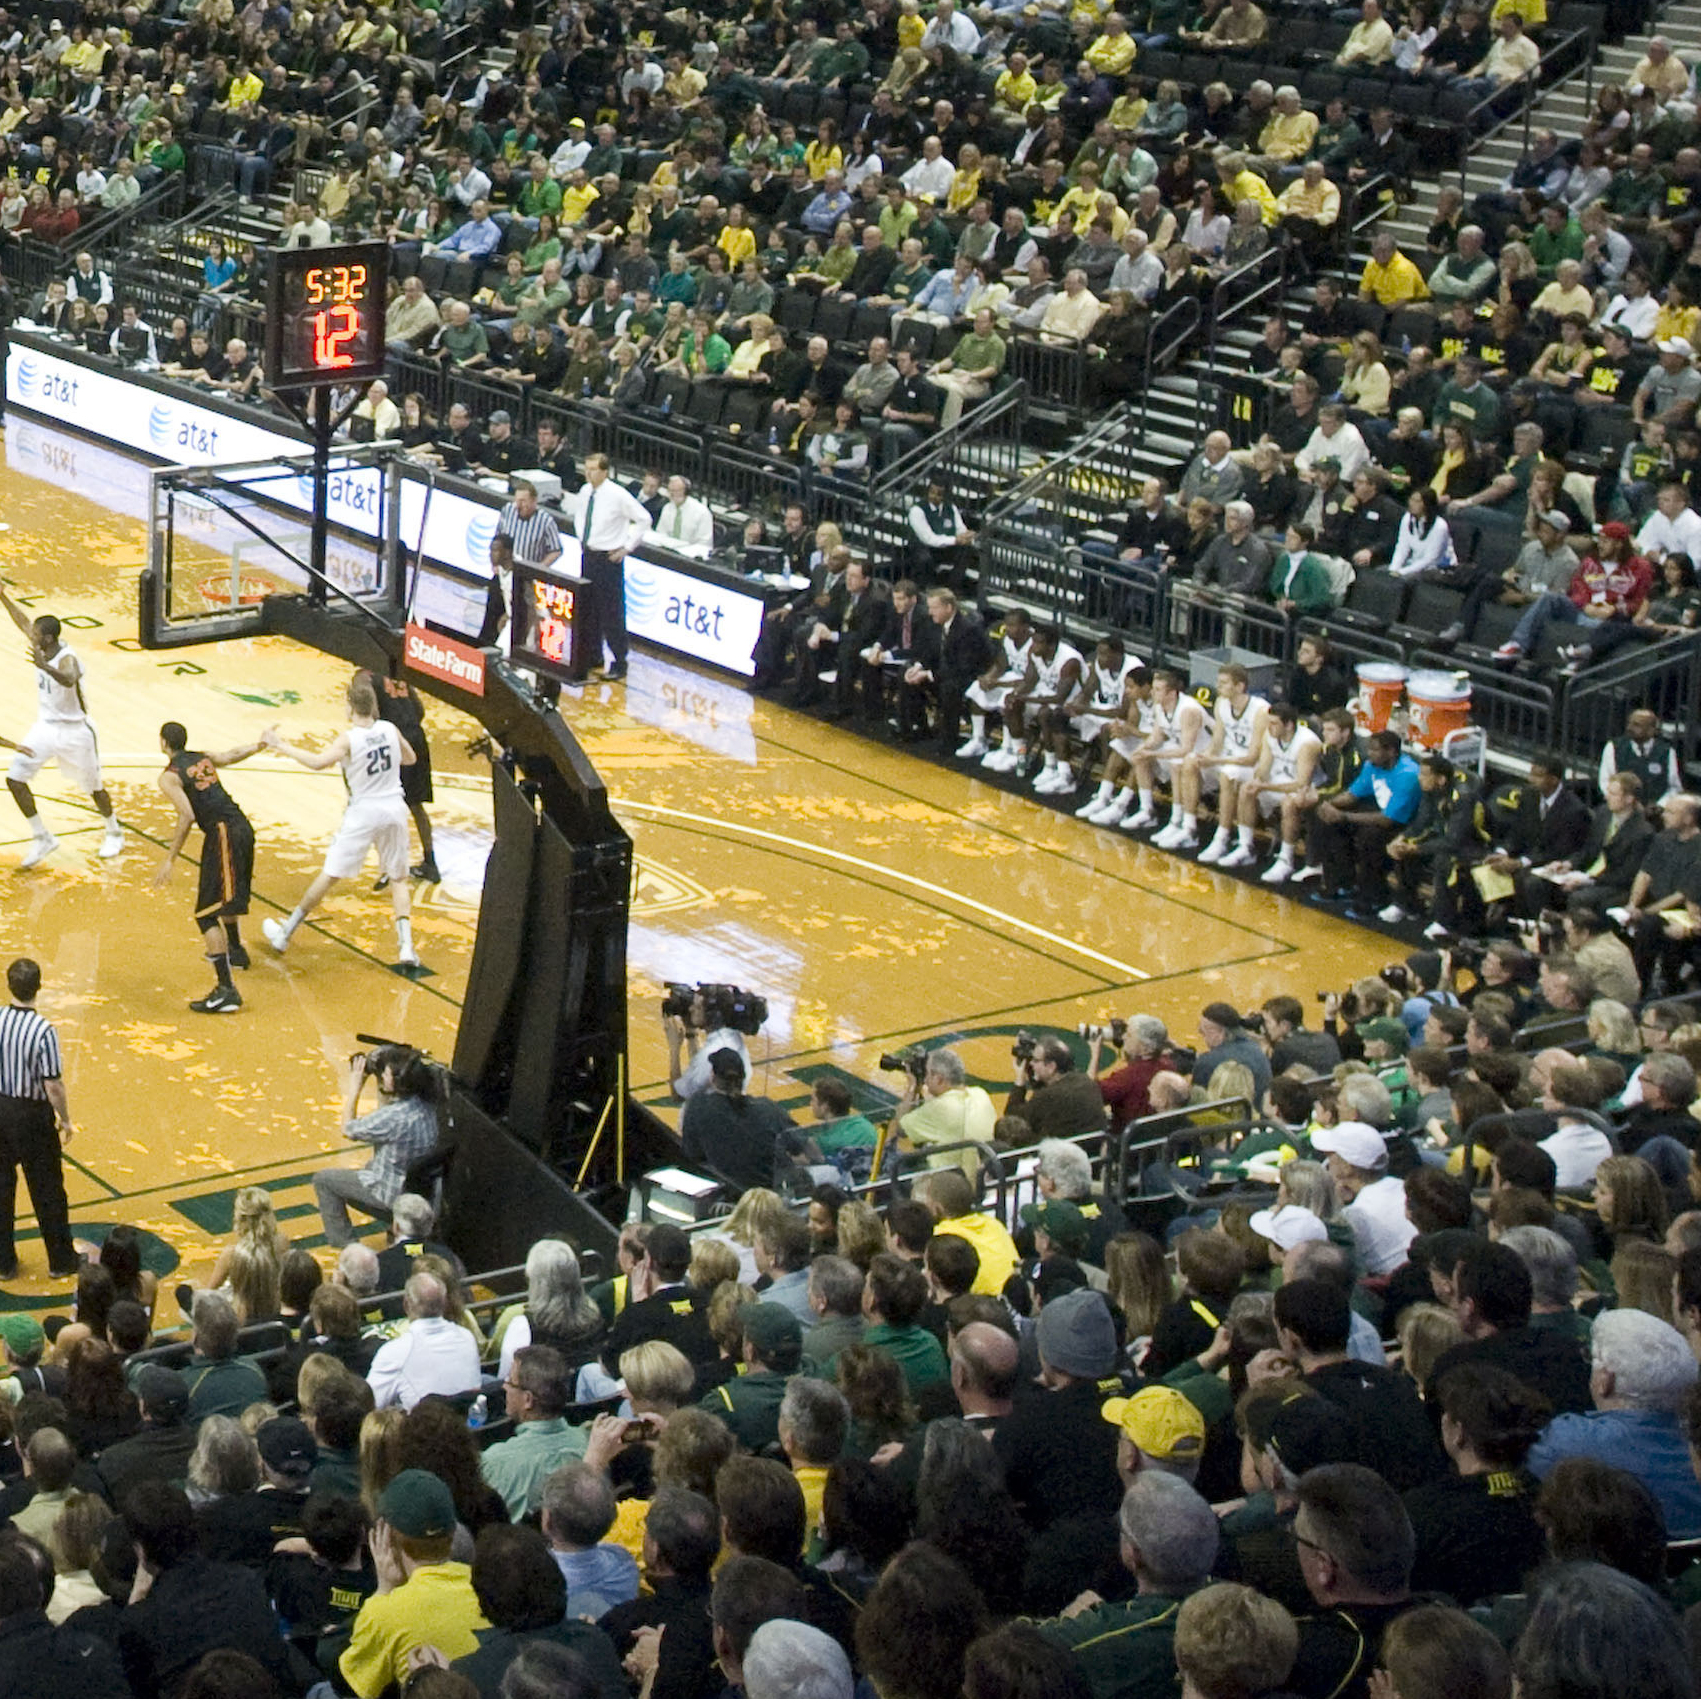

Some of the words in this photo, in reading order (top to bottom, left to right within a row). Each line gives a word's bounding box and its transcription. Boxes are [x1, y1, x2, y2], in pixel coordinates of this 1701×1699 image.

[306, 264, 367, 304] 5:32
[313, 304, 360, 370] 12
[42, 376, 80, 407] at&t
[177, 420, 219, 458] at&t
[329, 476, 377, 515] at&t
[663, 592, 726, 642] at&t
[366, 744, 392, 776] 25
